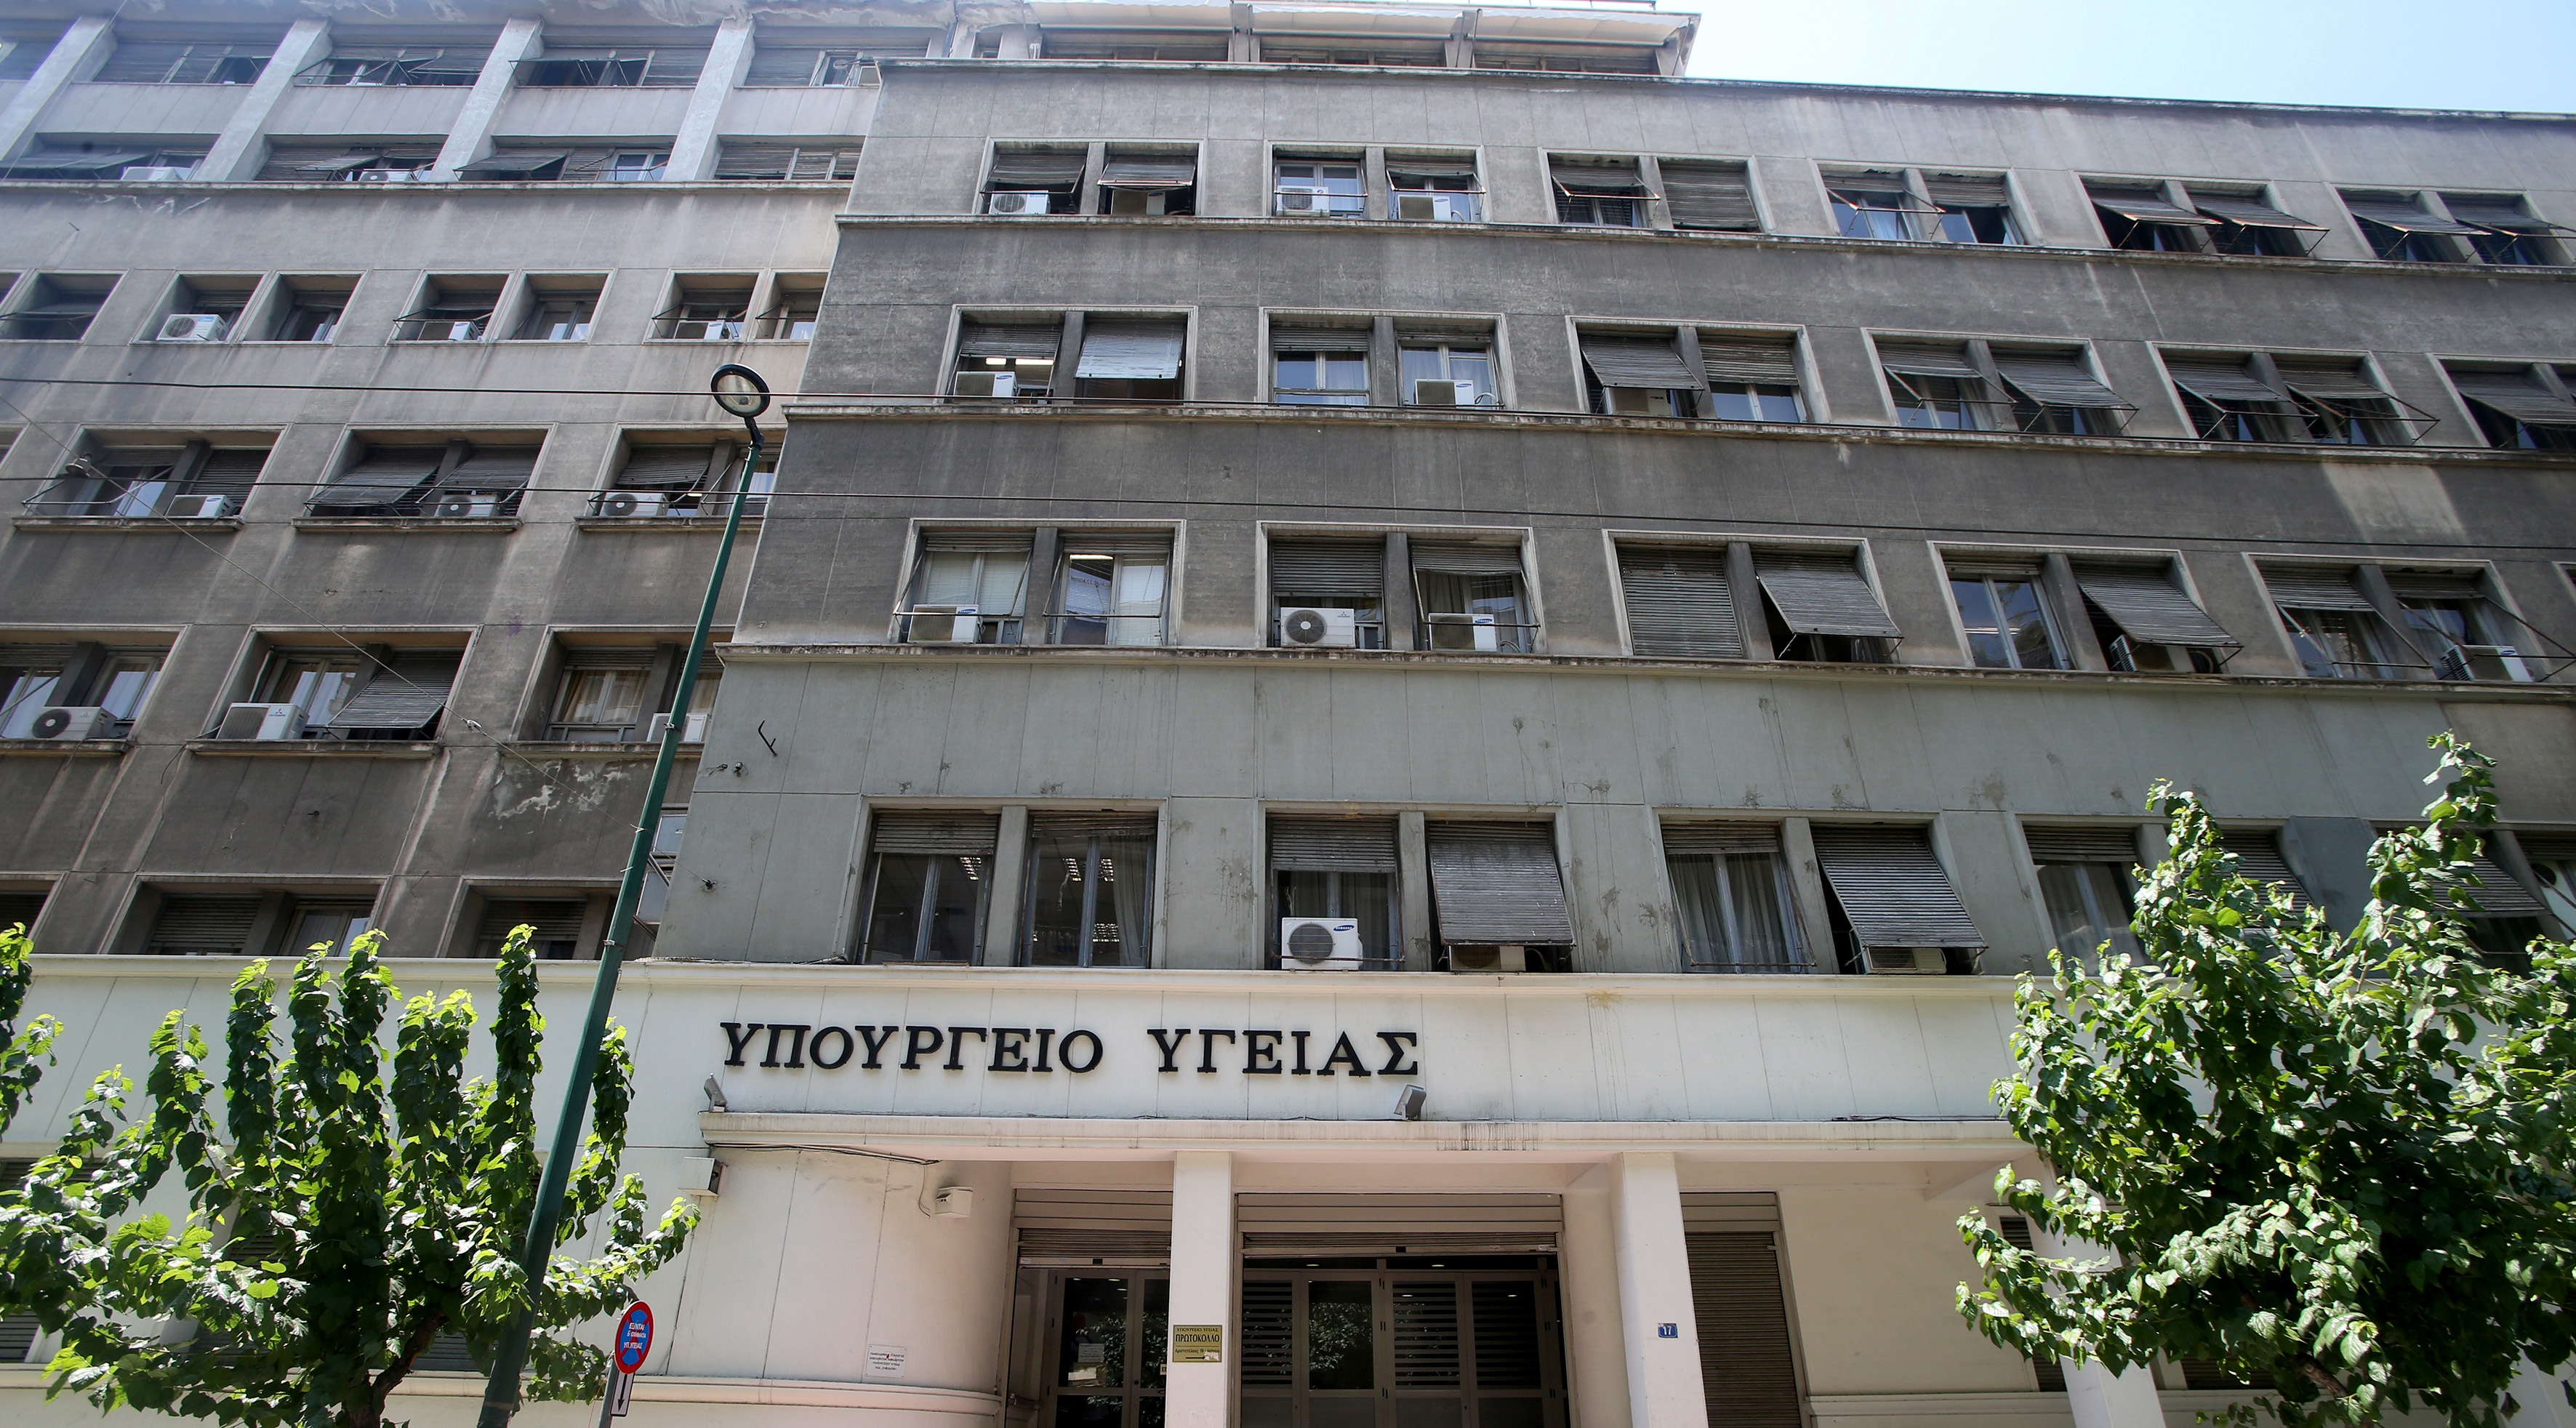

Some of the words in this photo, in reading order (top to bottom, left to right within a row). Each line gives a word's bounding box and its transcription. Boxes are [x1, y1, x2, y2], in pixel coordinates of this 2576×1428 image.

[720, 1022, 1104, 1074] ΥΠΟΥΡΓΕΙΟ
[1147, 1028, 1419, 1077] ΥΓΕΙΑΣ
[1663, 1325, 1672, 1336] 17
[1175, 1333, 1220, 1342] ΠΡΩΤΟΚΟΛΛΟ
